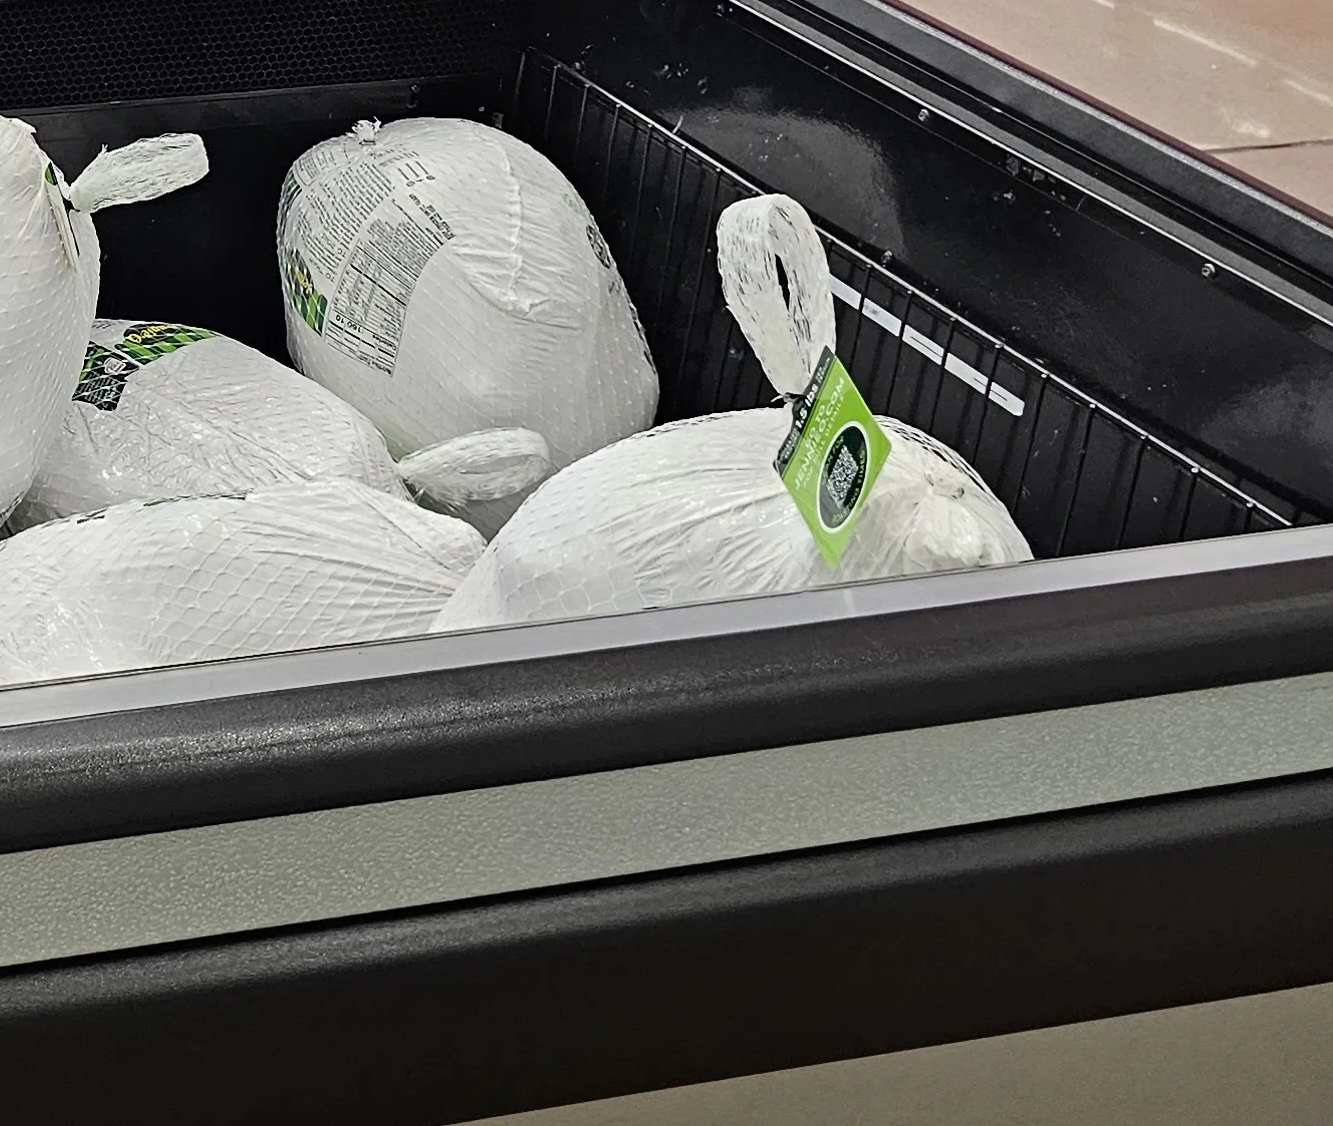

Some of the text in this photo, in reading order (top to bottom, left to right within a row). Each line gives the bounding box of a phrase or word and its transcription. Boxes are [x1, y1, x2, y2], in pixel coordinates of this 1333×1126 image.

[794, 377, 846, 491] JENNIEO.COM
[795, 383, 819, 428] 1.5 lbs
